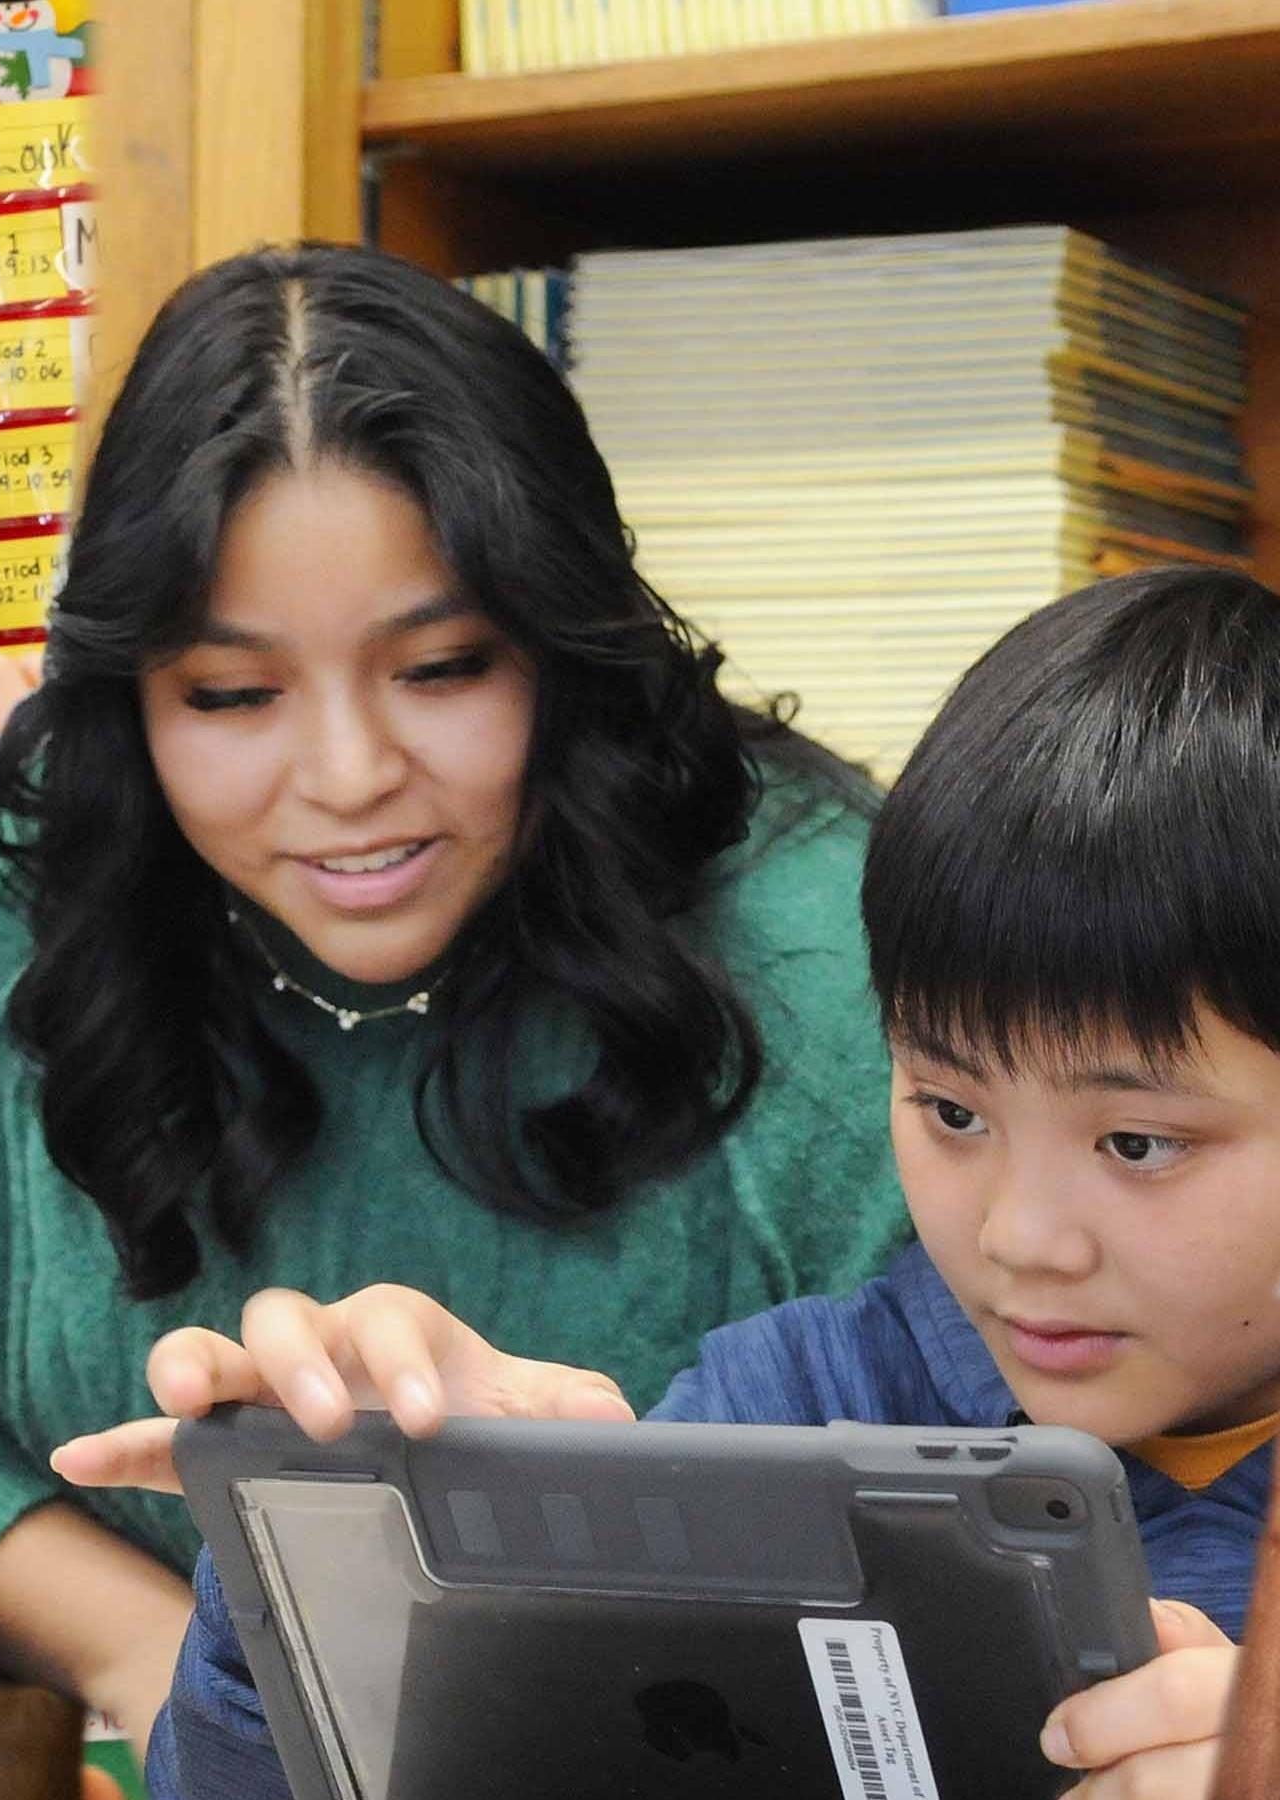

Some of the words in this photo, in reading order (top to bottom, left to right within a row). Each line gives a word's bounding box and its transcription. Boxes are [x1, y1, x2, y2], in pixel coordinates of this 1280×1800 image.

[8, 232, 19, 255] 1
[35, 339, 48, 359] 2
[41, 445, 53, 466] 3
[870, 1627, 891, 1674] Property
[888, 1689, 905, 1718] NYC
[876, 1714, 893, 1743] Asset
[885, 1746, 898, 1766] Tag
[895, 1720, 921, 1784] Department
